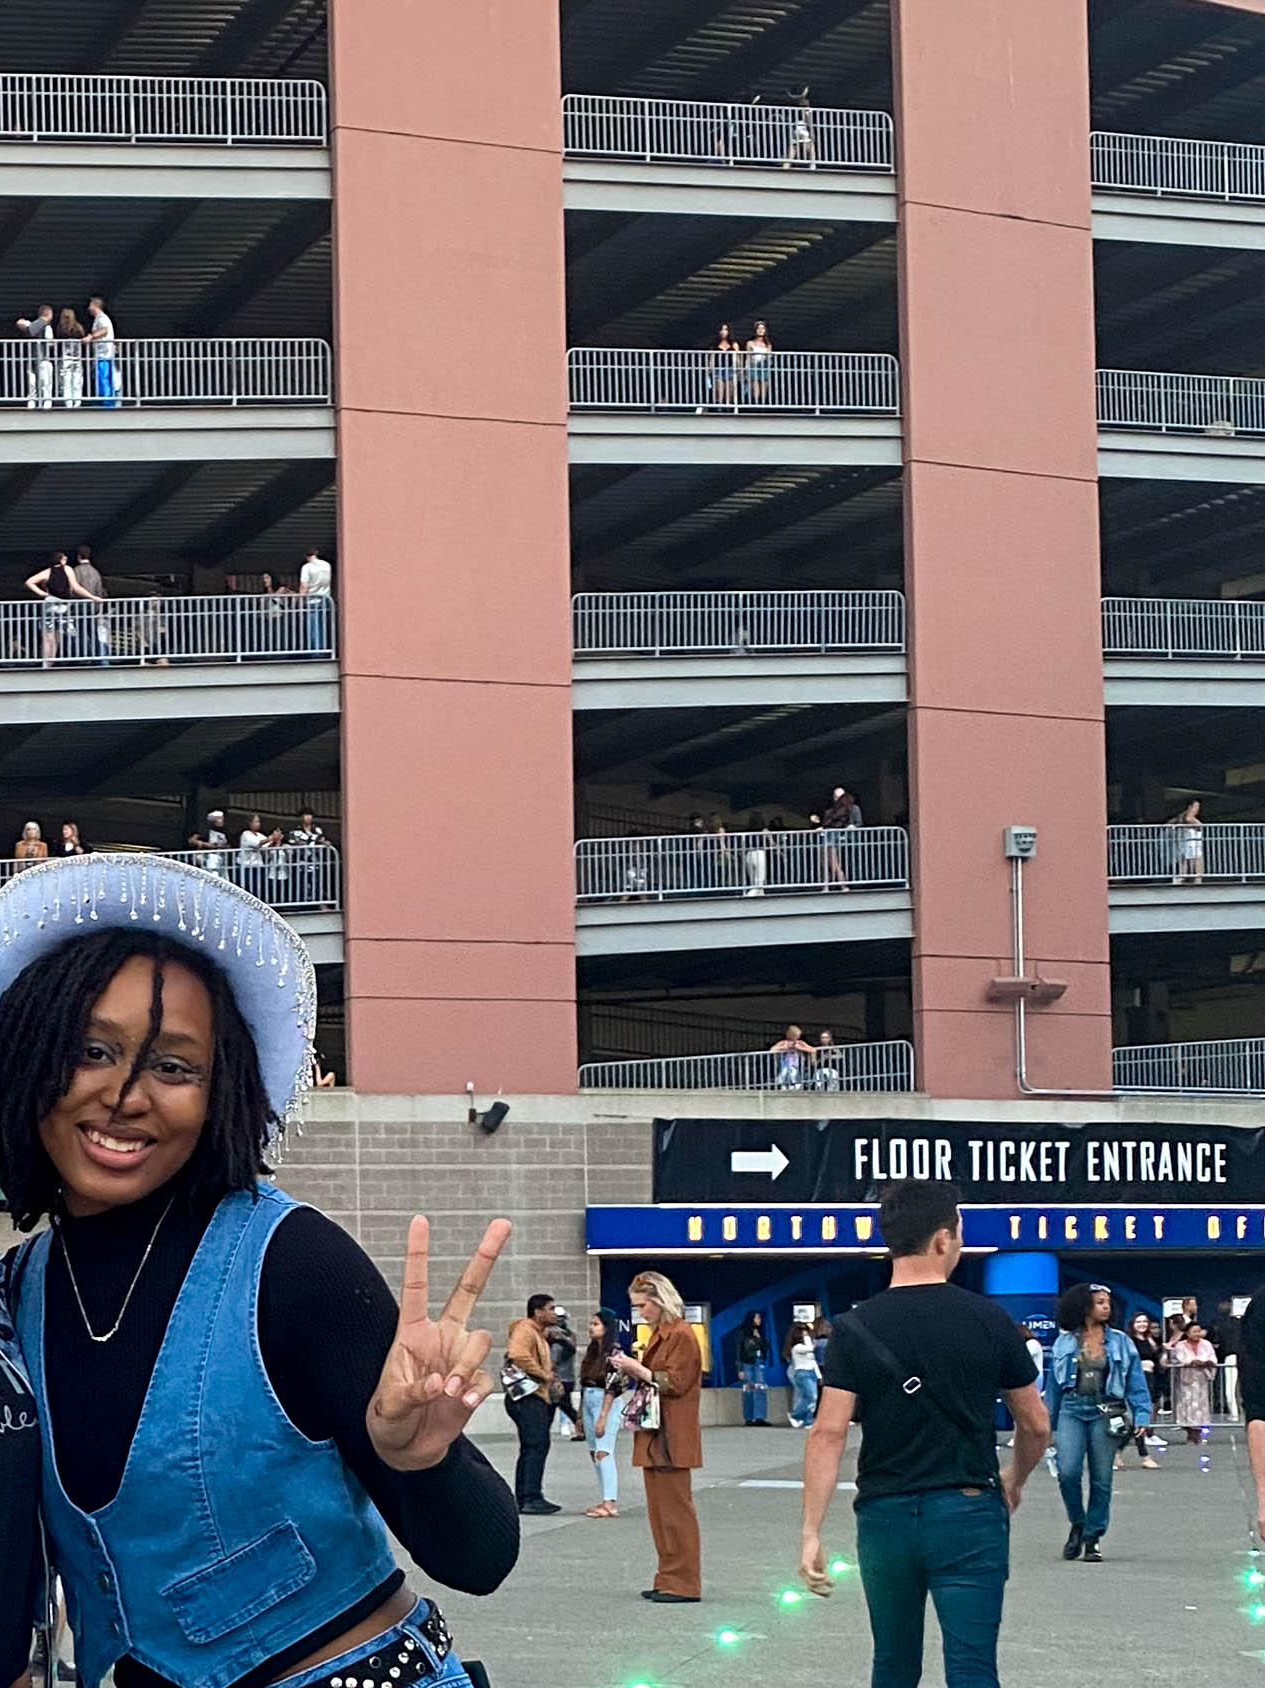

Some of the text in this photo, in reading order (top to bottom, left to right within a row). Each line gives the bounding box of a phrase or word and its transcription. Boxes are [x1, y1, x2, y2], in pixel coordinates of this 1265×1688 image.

[854, 1138, 1227, 1183] FLOOR TICKET ENTRANCE
[687, 1215, 1265, 1241] NORTHW TICKET OF
